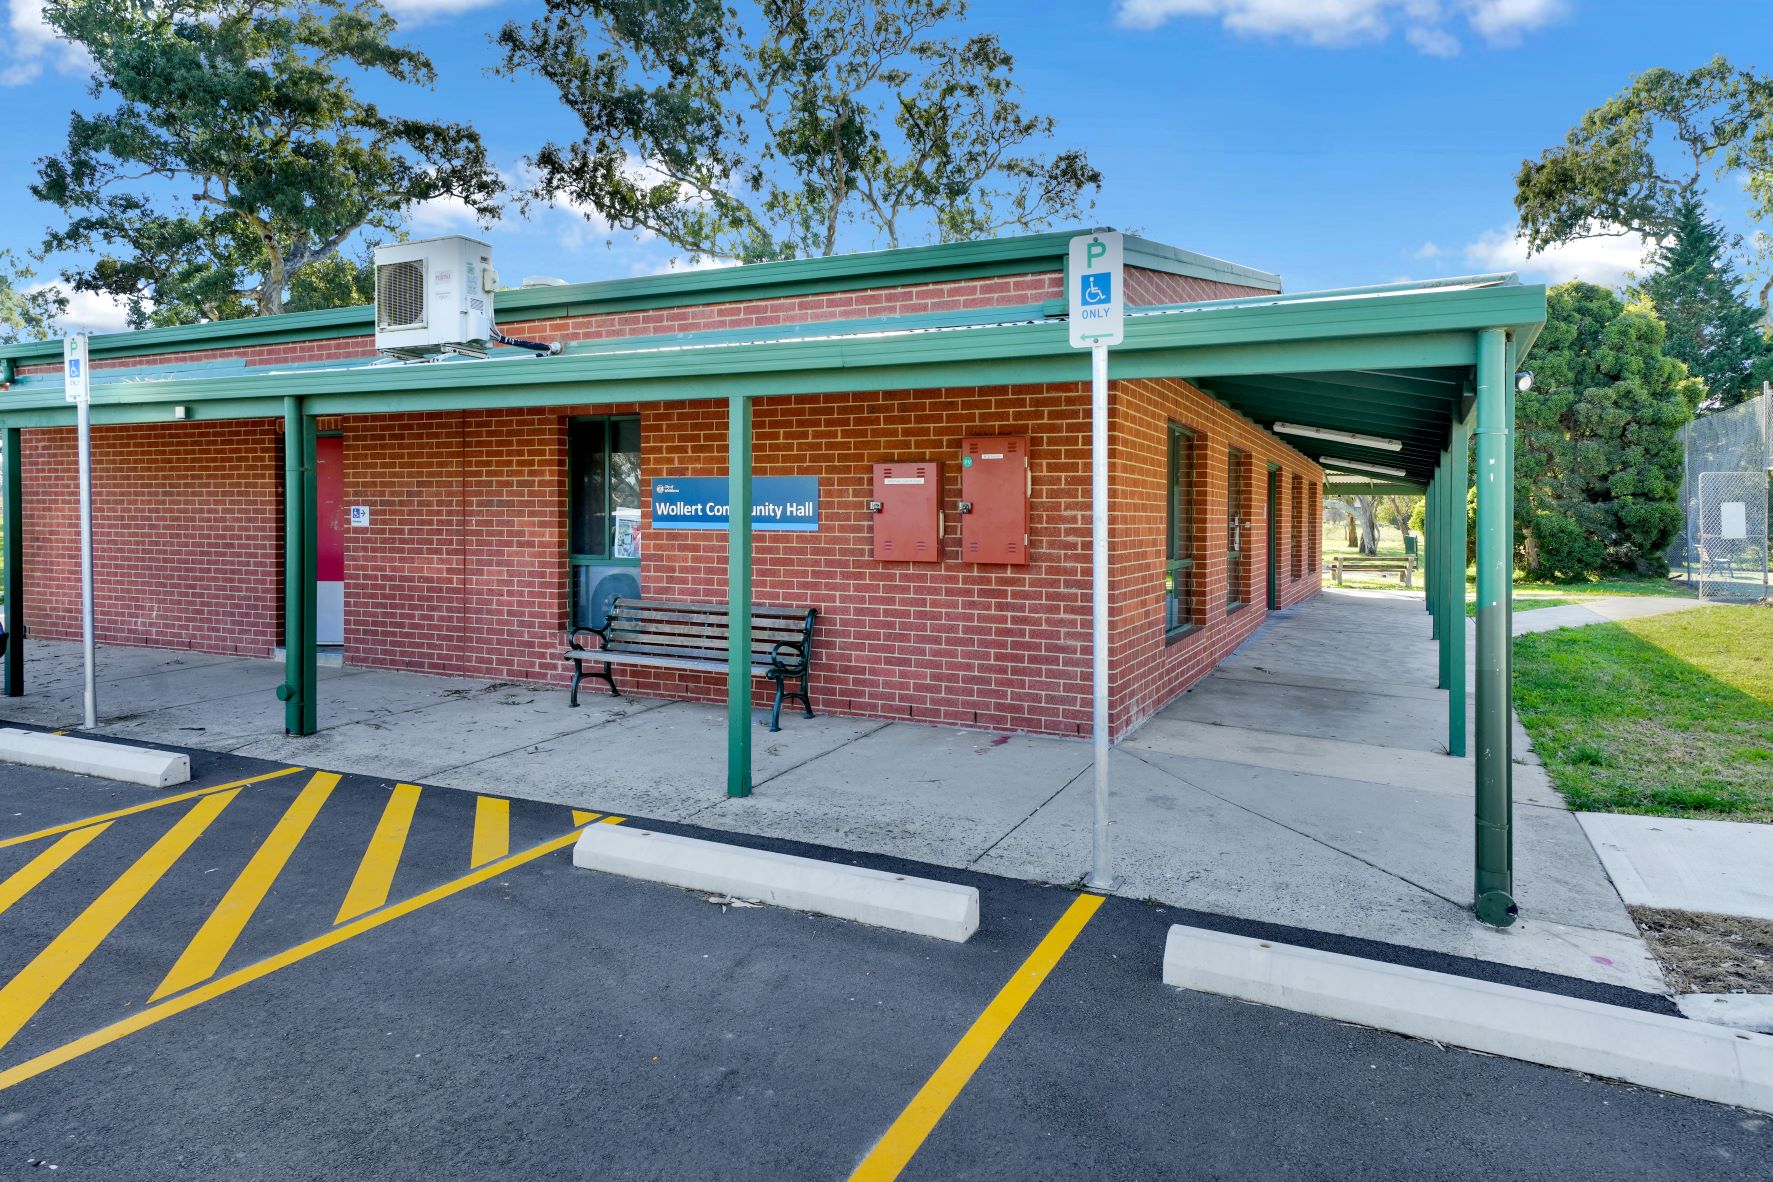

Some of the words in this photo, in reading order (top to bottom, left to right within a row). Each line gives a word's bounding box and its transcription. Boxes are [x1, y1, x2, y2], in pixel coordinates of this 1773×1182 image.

[1087, 241, 1107, 269] P
[1082, 307, 1110, 319] ONLY
[70, 341, 78, 357] P
[656, 502, 702, 516] Wollert
[706, 502, 783, 519] Comunity
[787, 502, 813, 517] Hall
